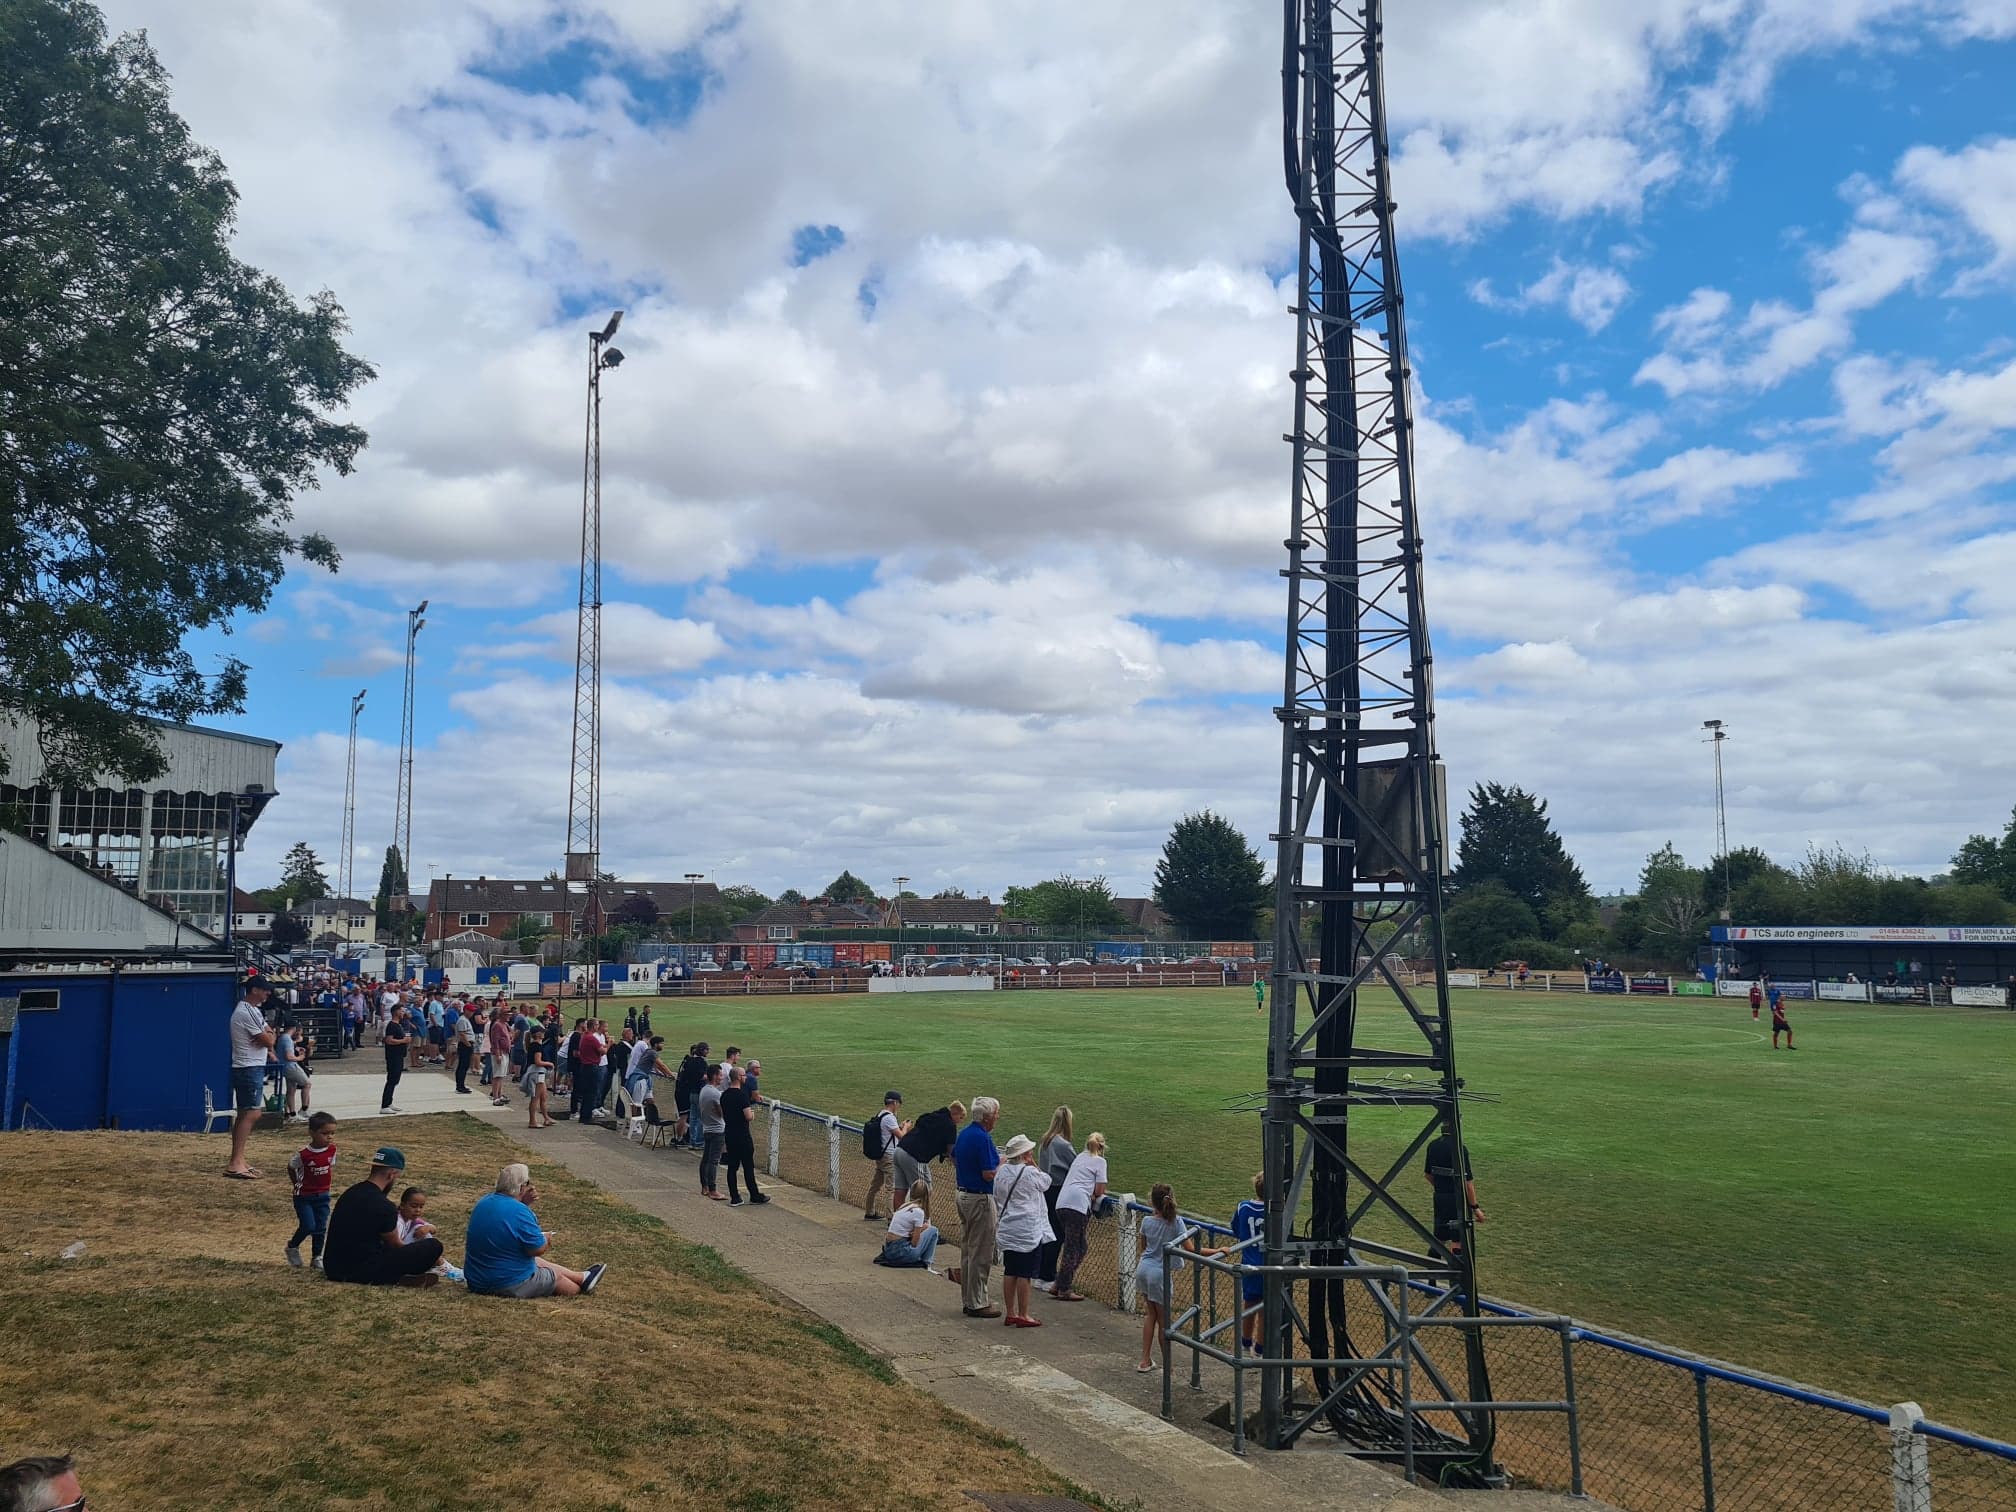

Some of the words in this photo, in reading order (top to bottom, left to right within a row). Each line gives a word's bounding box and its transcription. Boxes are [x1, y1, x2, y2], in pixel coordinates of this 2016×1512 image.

[1752, 928, 1771, 938] TCS
[1774, 929, 1794, 938] auto
[1797, 928, 1844, 940] engineers
